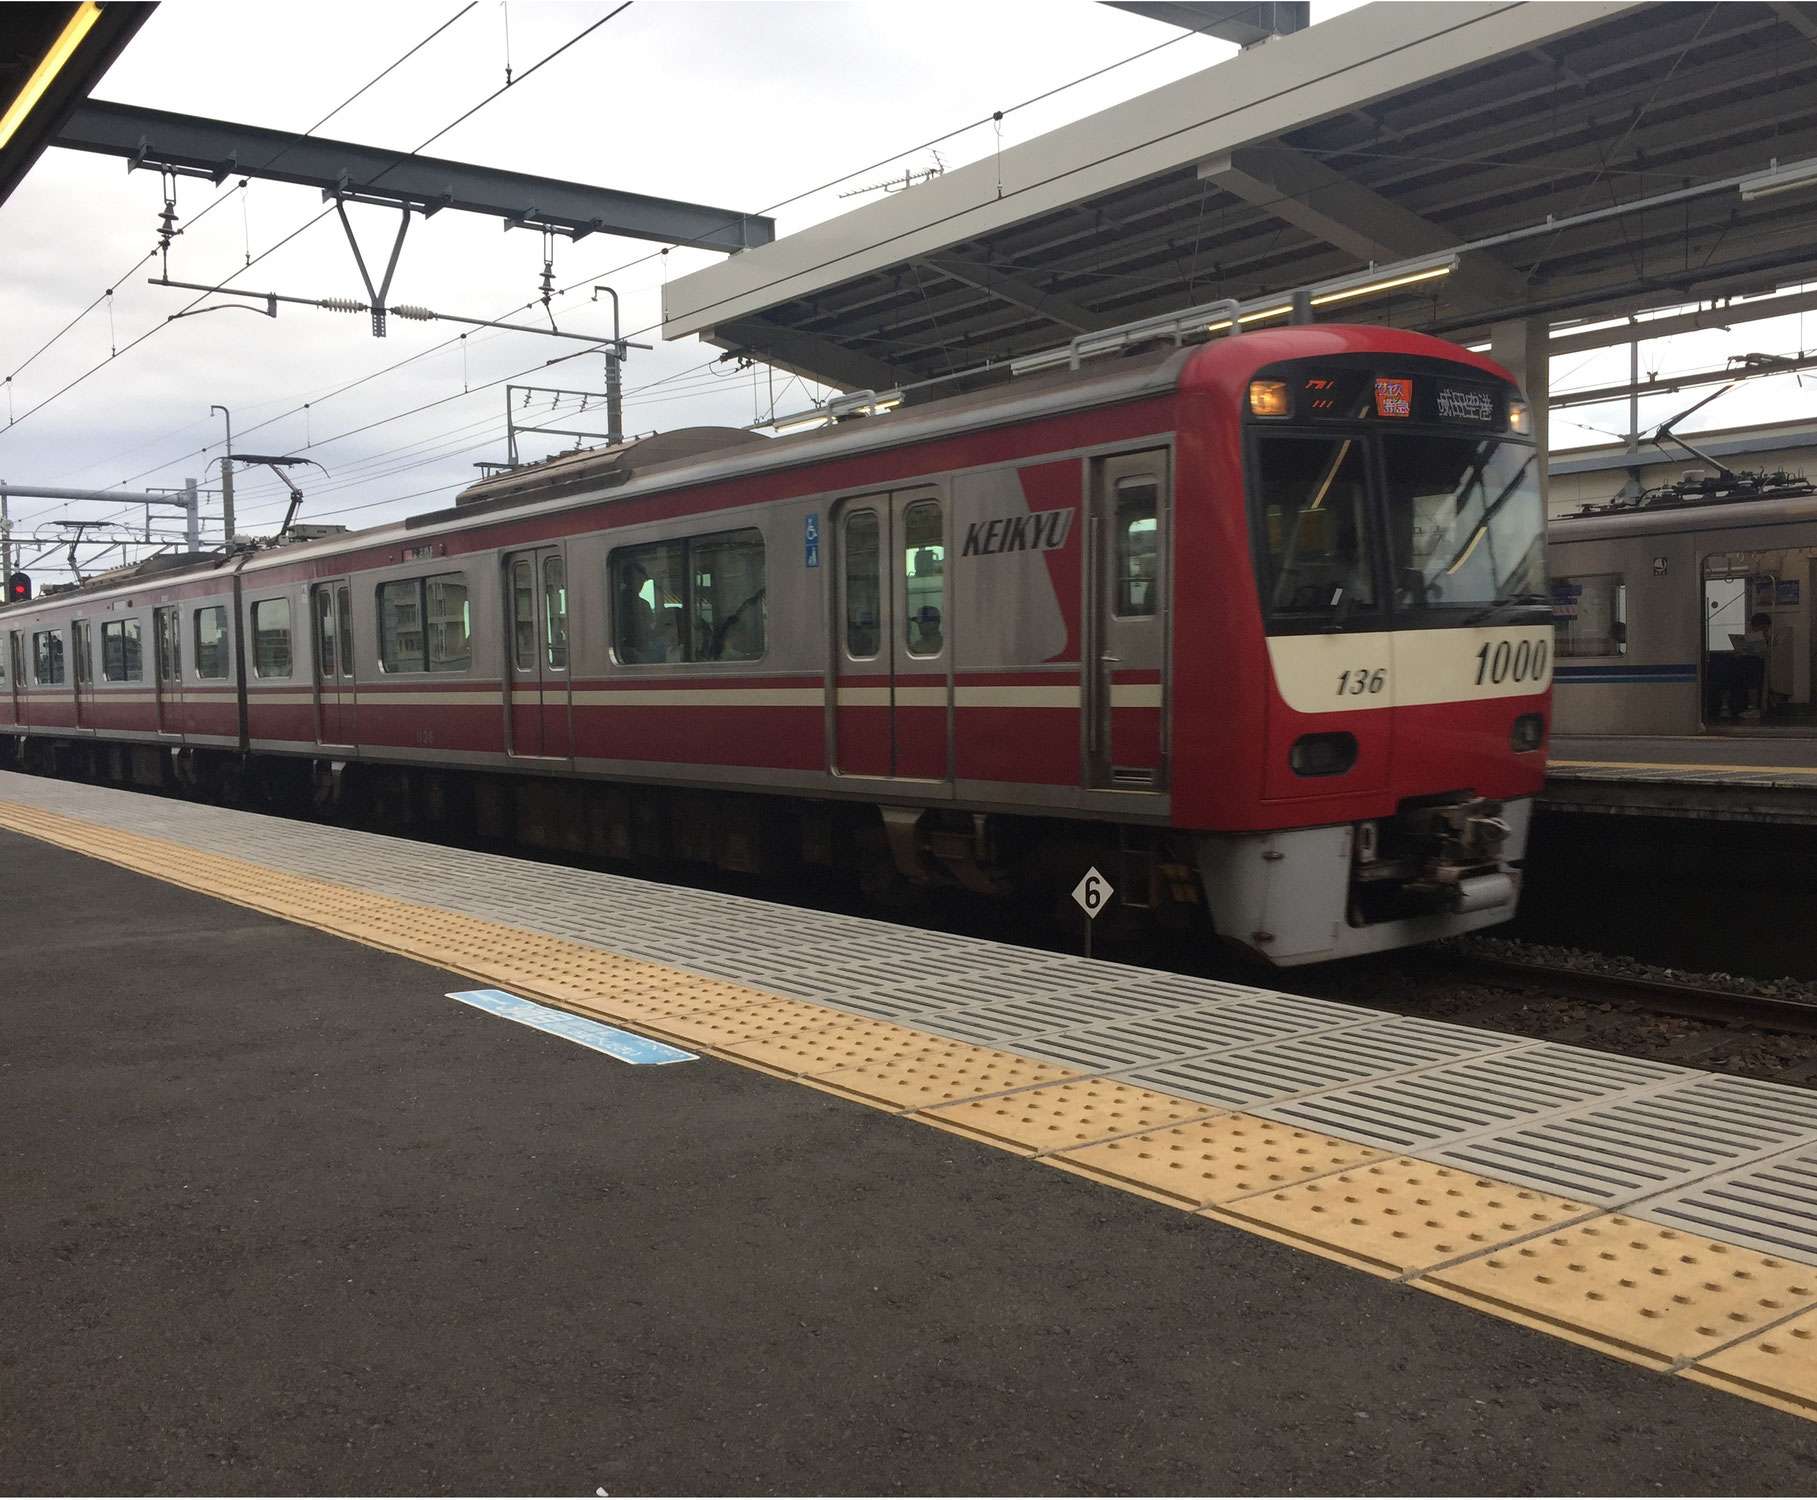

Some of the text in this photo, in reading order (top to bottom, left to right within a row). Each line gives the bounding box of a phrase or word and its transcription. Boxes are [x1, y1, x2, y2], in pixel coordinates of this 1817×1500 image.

[961, 509, 1072, 557] KEIKYU
[1336, 668, 1388, 696] 136
[1475, 639, 1548, 686] 1000
[1085, 876, 1101, 909] 6
